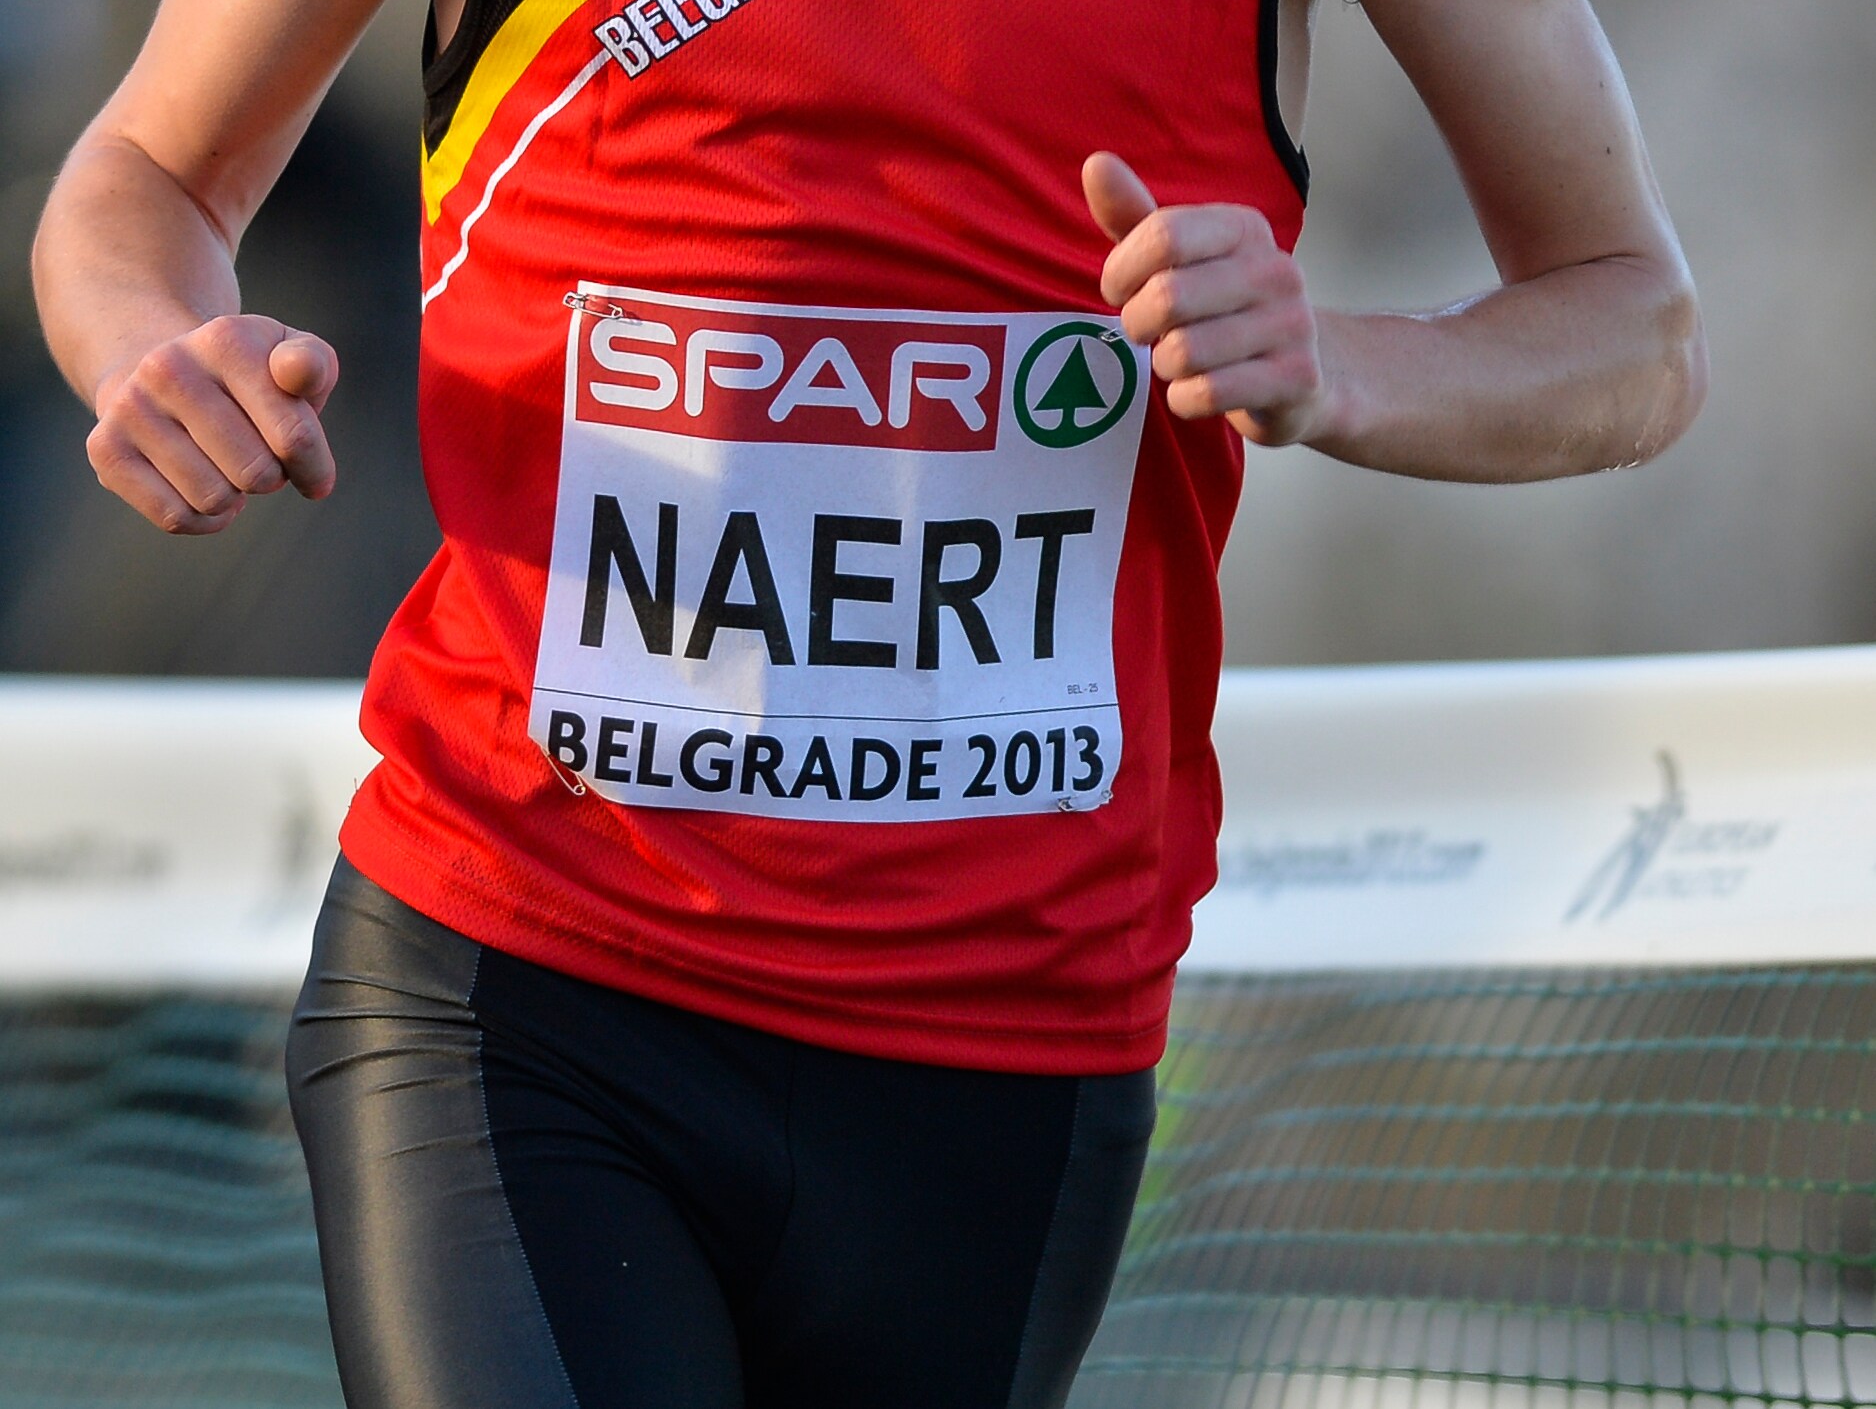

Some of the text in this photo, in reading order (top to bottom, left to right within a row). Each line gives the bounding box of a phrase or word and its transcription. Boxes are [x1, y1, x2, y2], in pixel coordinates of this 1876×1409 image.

[588, 319, 991, 431] SPAR
[579, 493, 1096, 671] NAERT
[547, 710, 1103, 802] BELGRADE 2013
